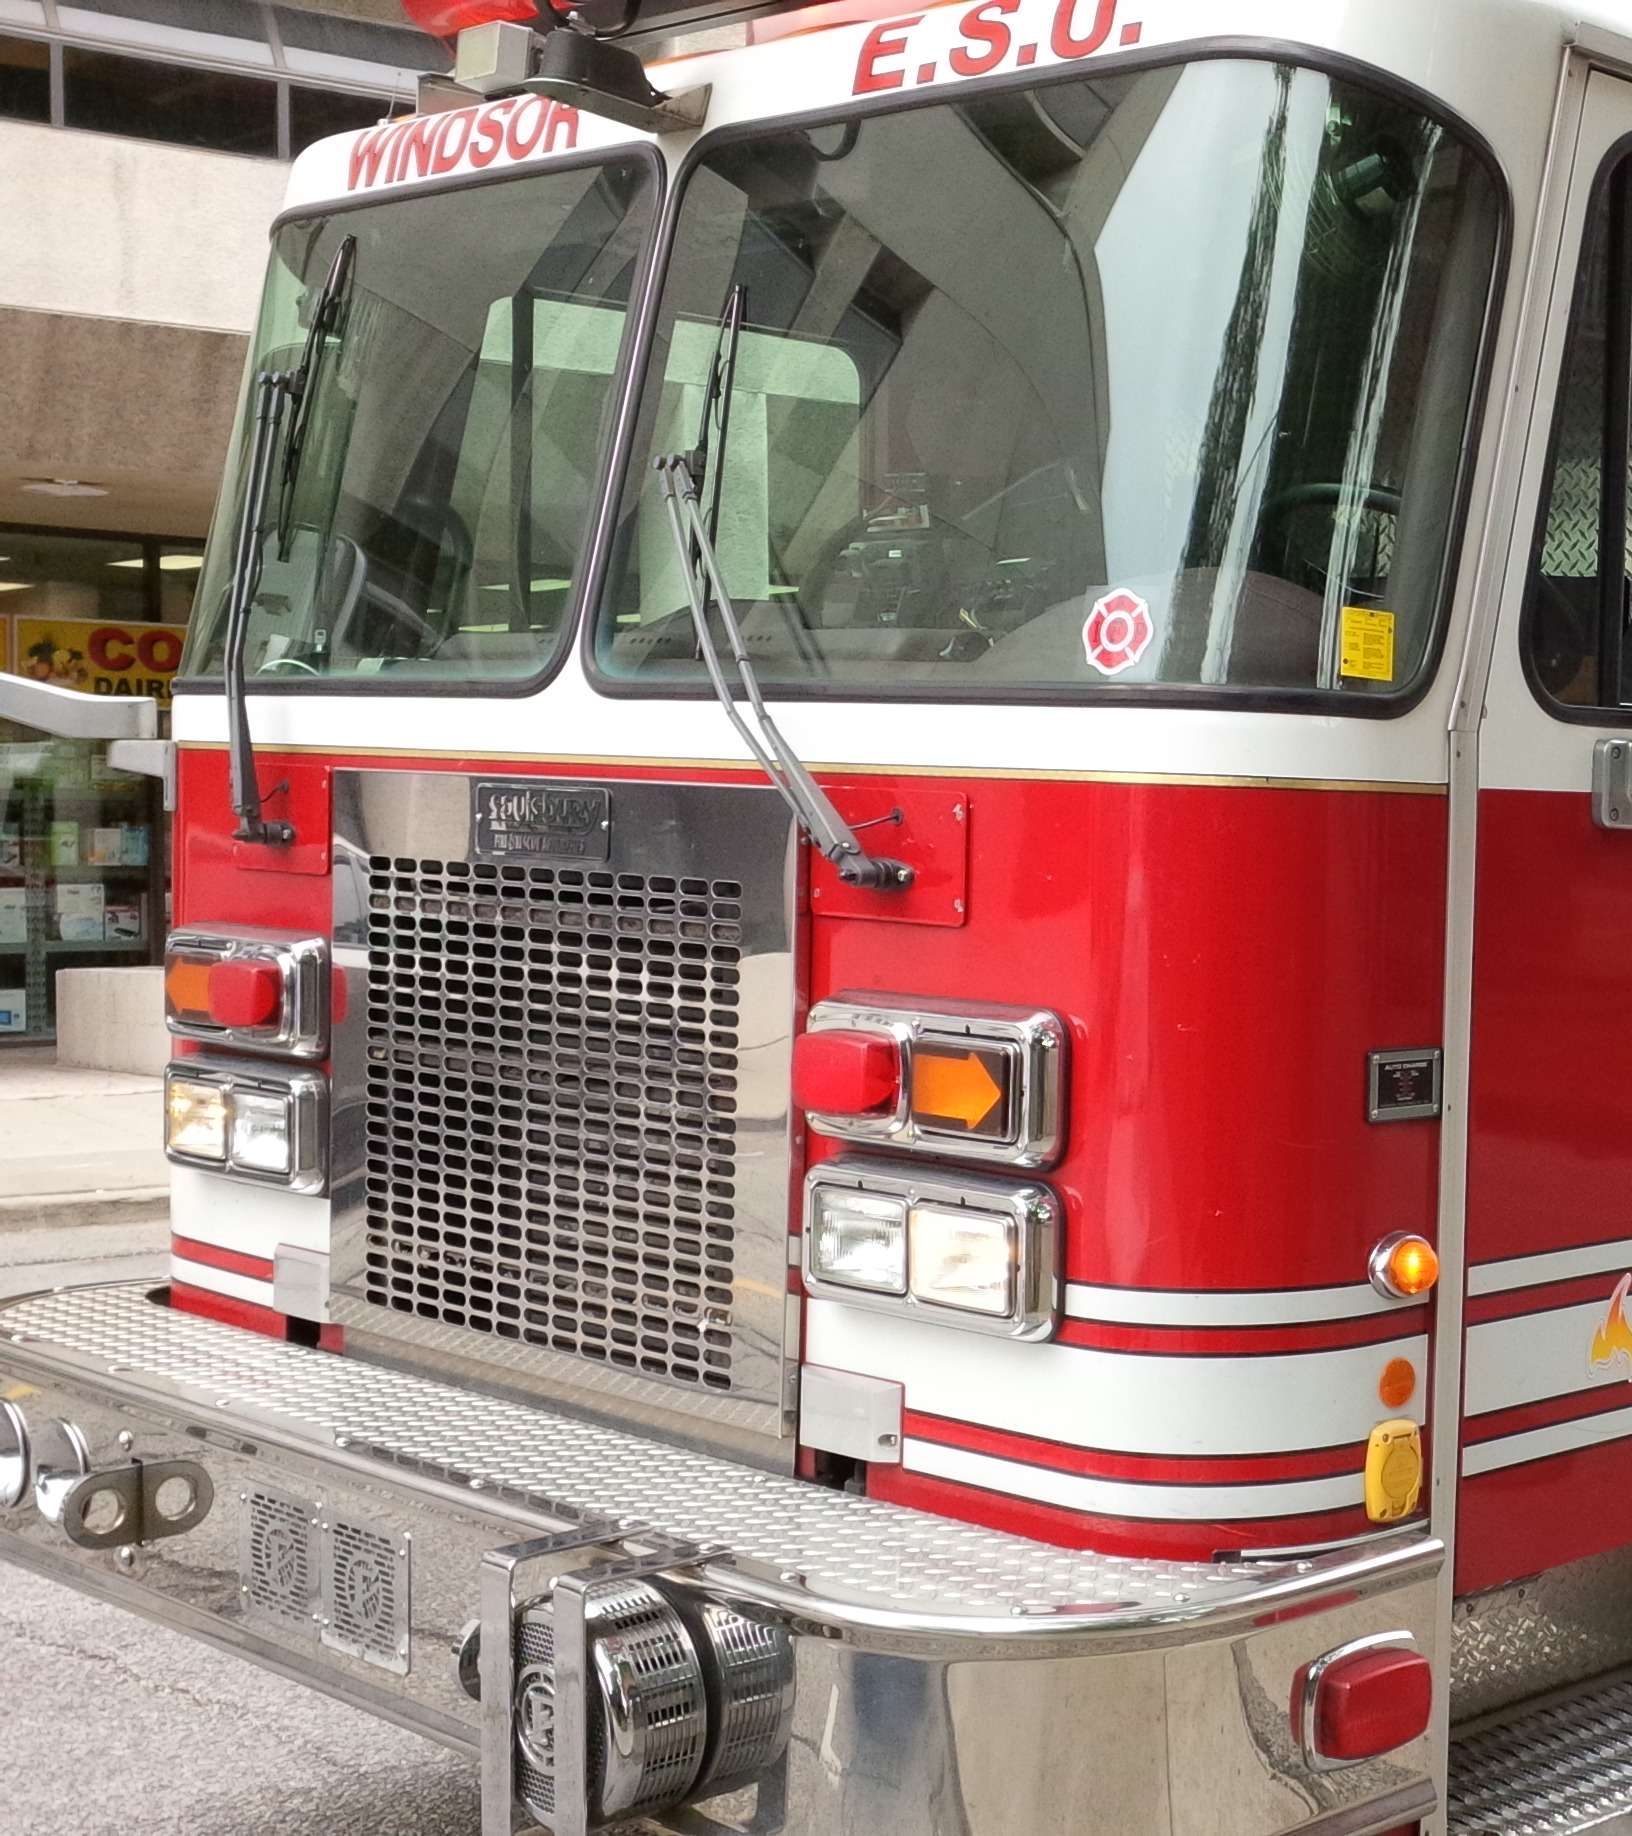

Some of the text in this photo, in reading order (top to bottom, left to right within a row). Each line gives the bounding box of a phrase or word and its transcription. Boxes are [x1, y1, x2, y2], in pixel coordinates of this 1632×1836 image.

[852, 0, 1143, 96] E.S.U.
[348, 95, 579, 191] WINDSOR
[94, 676, 172, 699] DAIR
